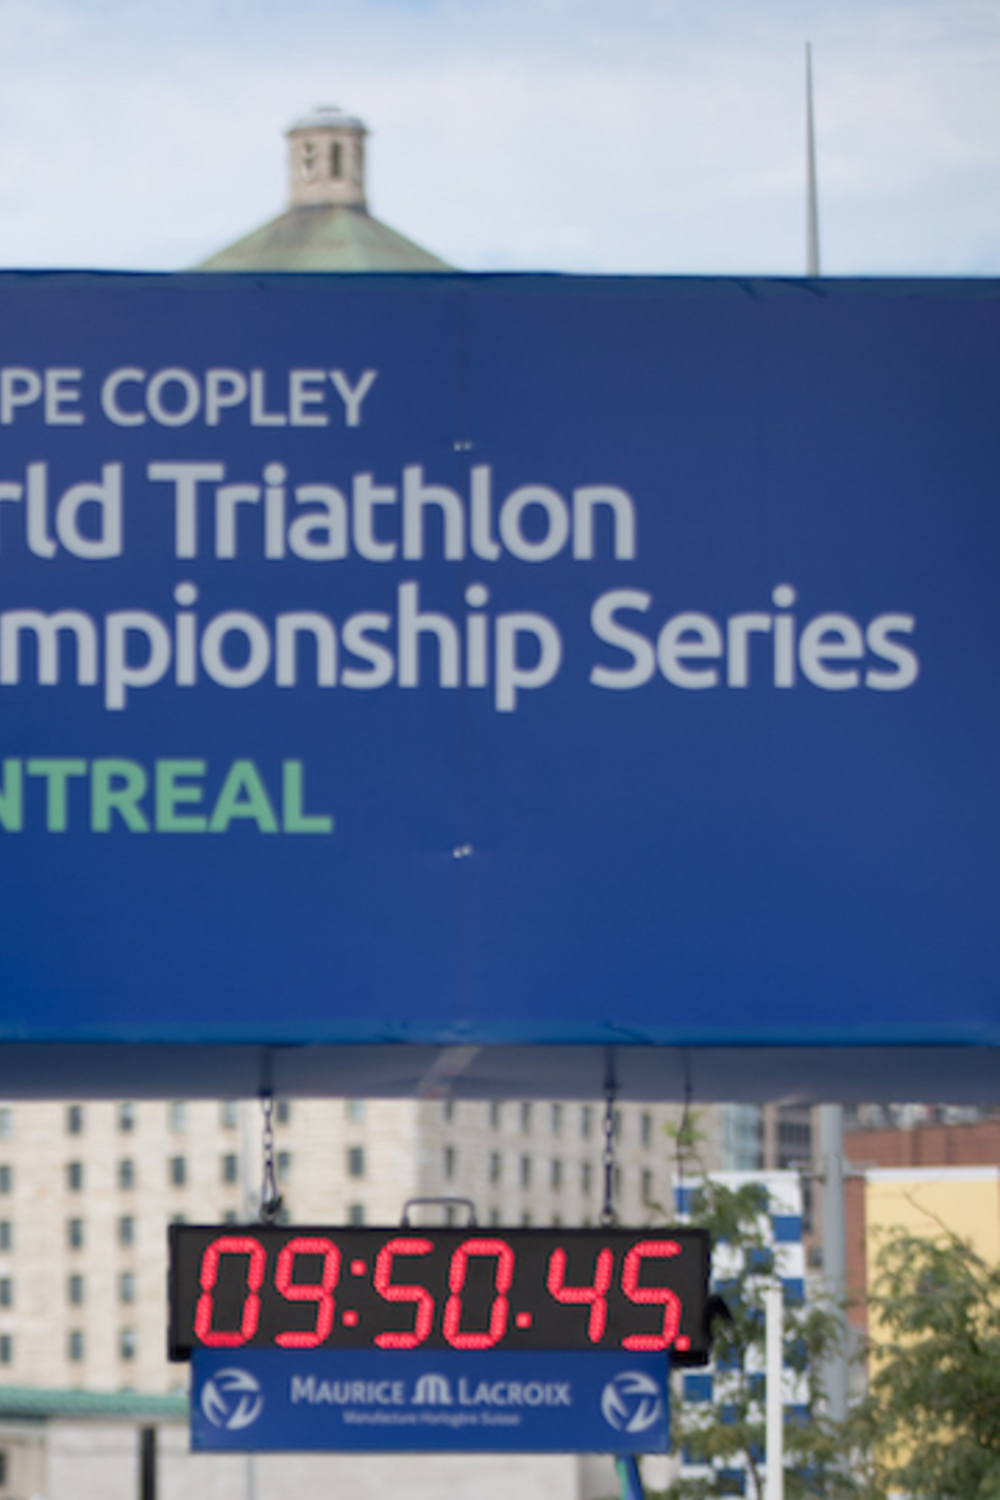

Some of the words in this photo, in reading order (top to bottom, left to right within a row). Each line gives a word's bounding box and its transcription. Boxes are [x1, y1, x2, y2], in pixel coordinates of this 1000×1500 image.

[101, 367, 377, 426] COPLEY
[148, 461, 636, 561] Triathlon
[590, 583, 919, 690] Series
[291, 1376, 404, 1404] MAURICE
[458, 1378, 571, 1405] LACROIX
